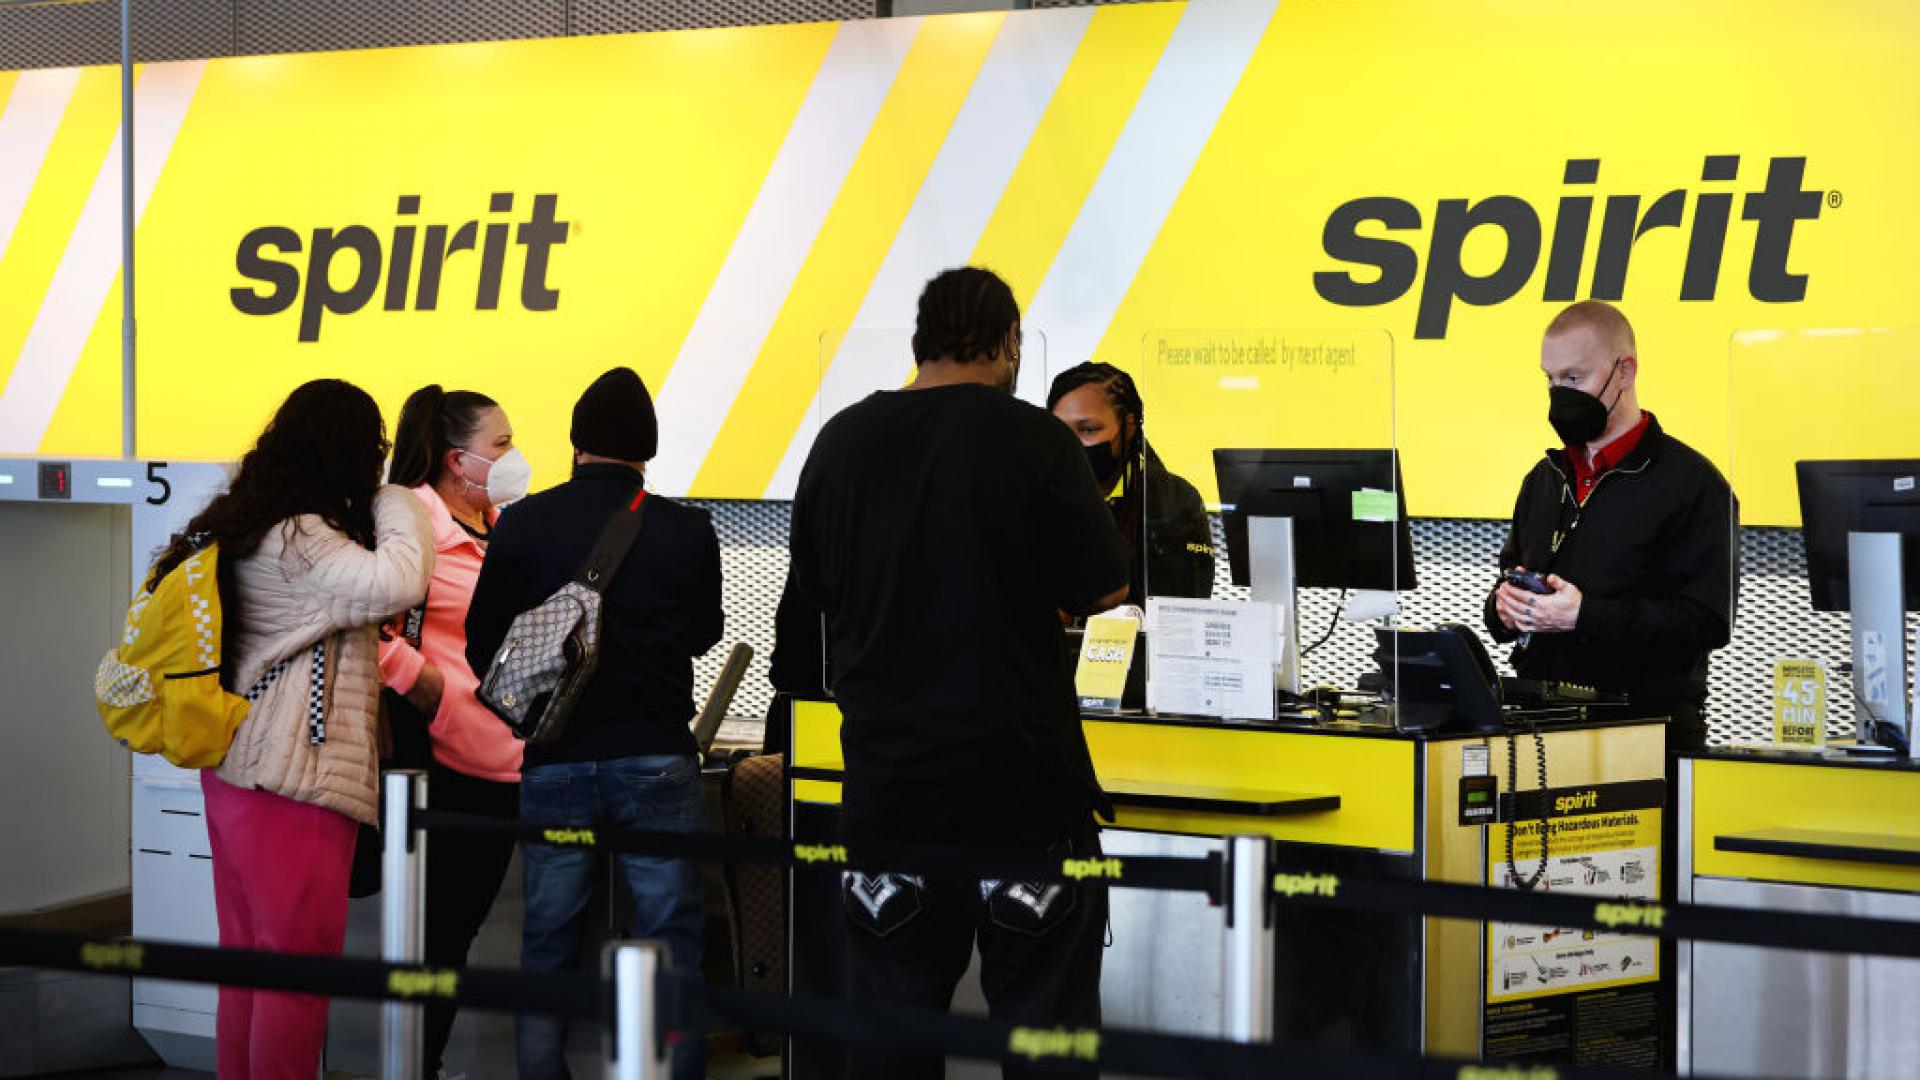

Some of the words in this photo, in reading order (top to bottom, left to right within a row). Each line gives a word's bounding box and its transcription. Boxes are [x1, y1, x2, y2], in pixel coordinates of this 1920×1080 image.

[230, 192, 570, 342] spirit
[1158, 338, 1191, 367] Please
[1194, 341, 1216, 366] wait
[1219, 342, 1230, 366] to
[1232, 338, 1245, 366] be
[1247, 337, 1276, 366] called
[1281, 337, 1294, 371] by
[1298, 342, 1322, 366] next
[1325, 340, 1355, 373] agent
[146, 461, 171, 505] 5
[1782, 679, 1816, 706] 45
[1782, 706, 1816, 725] MIN
[1555, 790, 1599, 814] spirit
[543, 827, 596, 845] spirit
[1557, 817, 1600, 832] Hazardous
[794, 843, 848, 864] spirit
[1062, 856, 1123, 880] spirit
[1273, 871, 1341, 898] spirit
[1594, 902, 1667, 928] spirit
